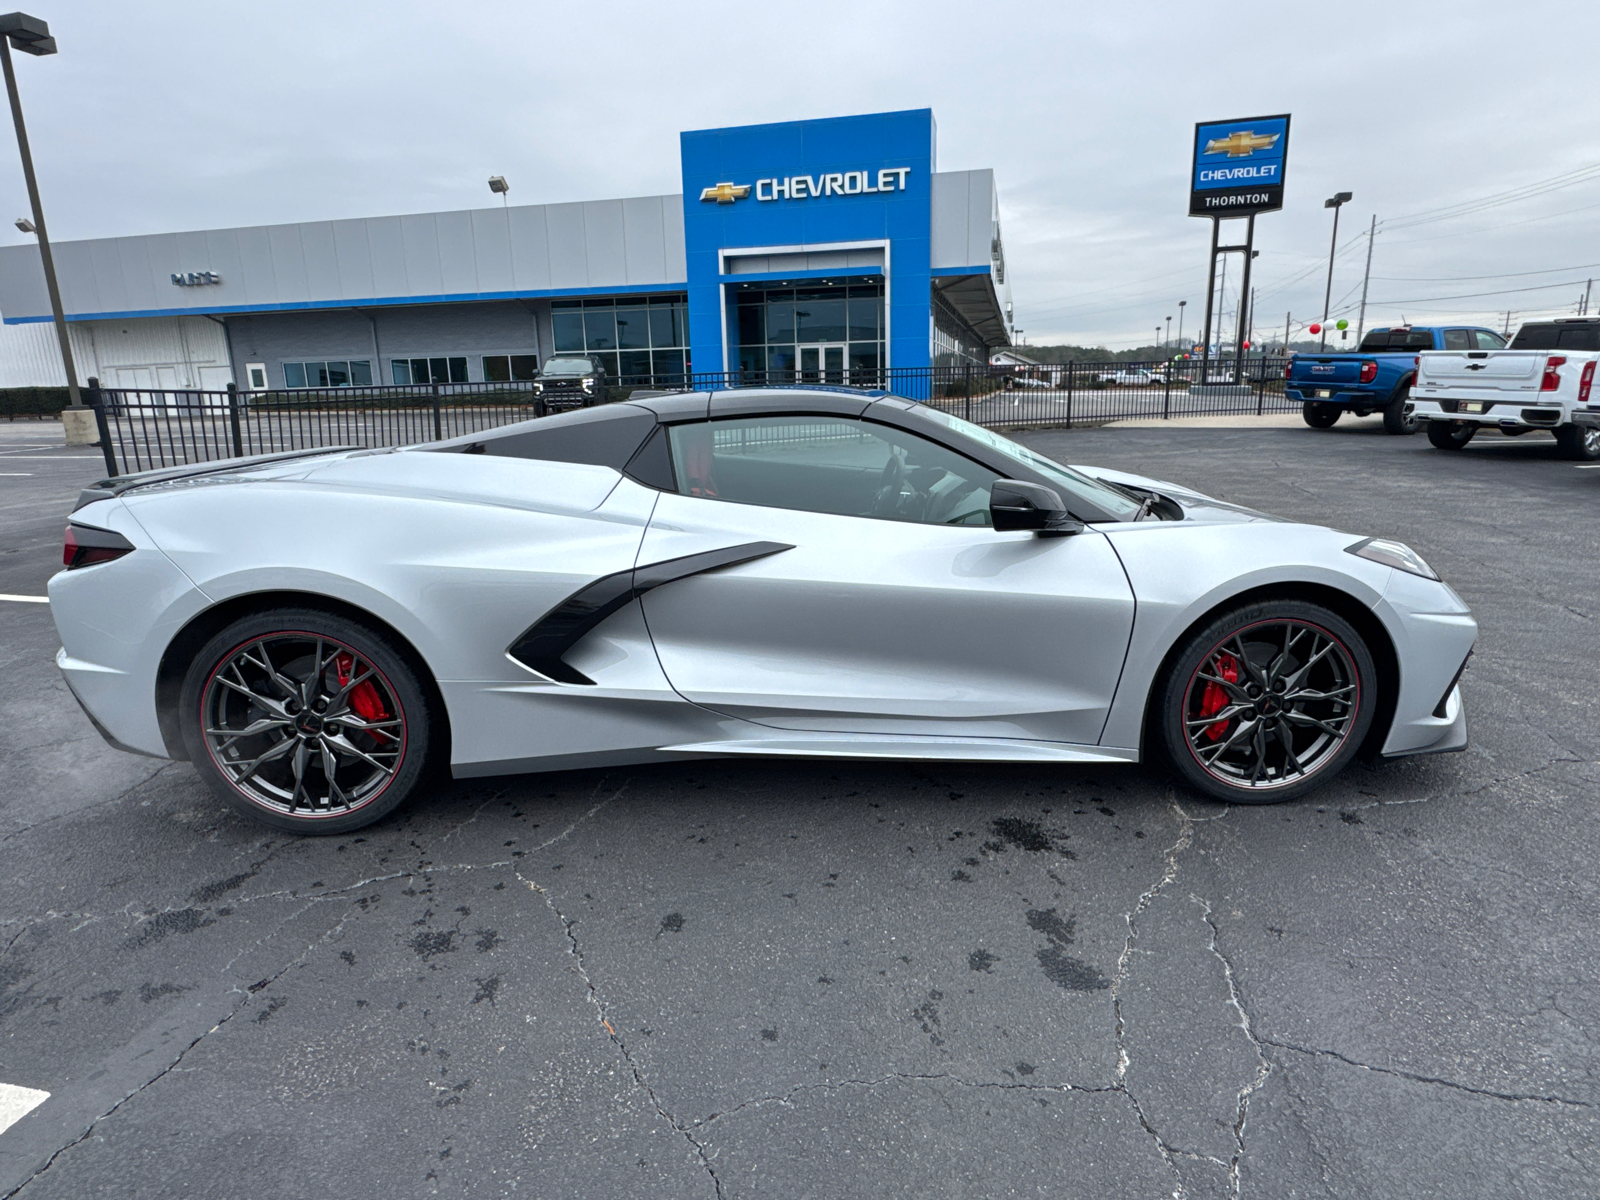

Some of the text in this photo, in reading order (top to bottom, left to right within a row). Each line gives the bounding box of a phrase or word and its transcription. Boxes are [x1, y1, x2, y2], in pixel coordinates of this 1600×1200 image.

[1200, 165, 1277, 181] CHEVROLET
[756, 167, 911, 201] CHEVROLET
[1205, 193, 1269, 207] THORNTON
